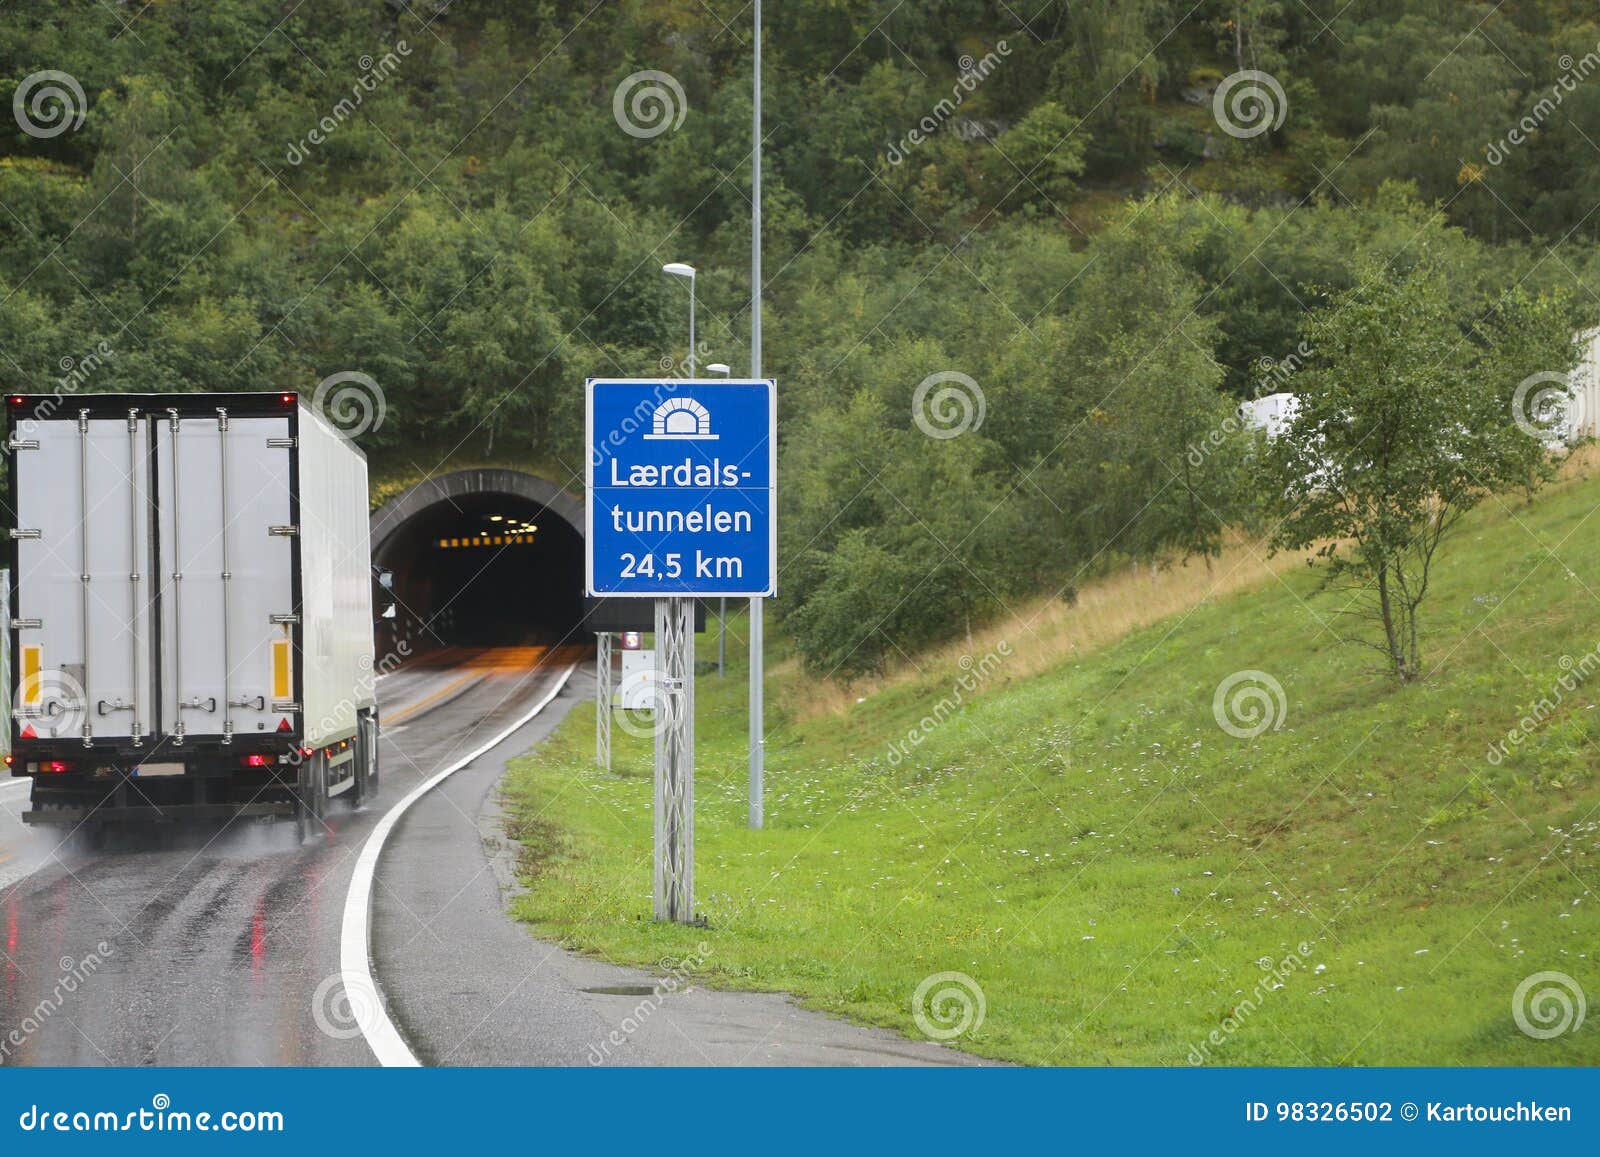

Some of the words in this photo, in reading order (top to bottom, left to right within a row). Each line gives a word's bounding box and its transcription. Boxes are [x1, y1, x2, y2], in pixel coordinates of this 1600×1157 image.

[611, 457, 751, 487] Lærdals-
[611, 503, 752, 532] tunnelen
[620, 552, 682, 581] 24,5
[696, 549, 742, 578] km
